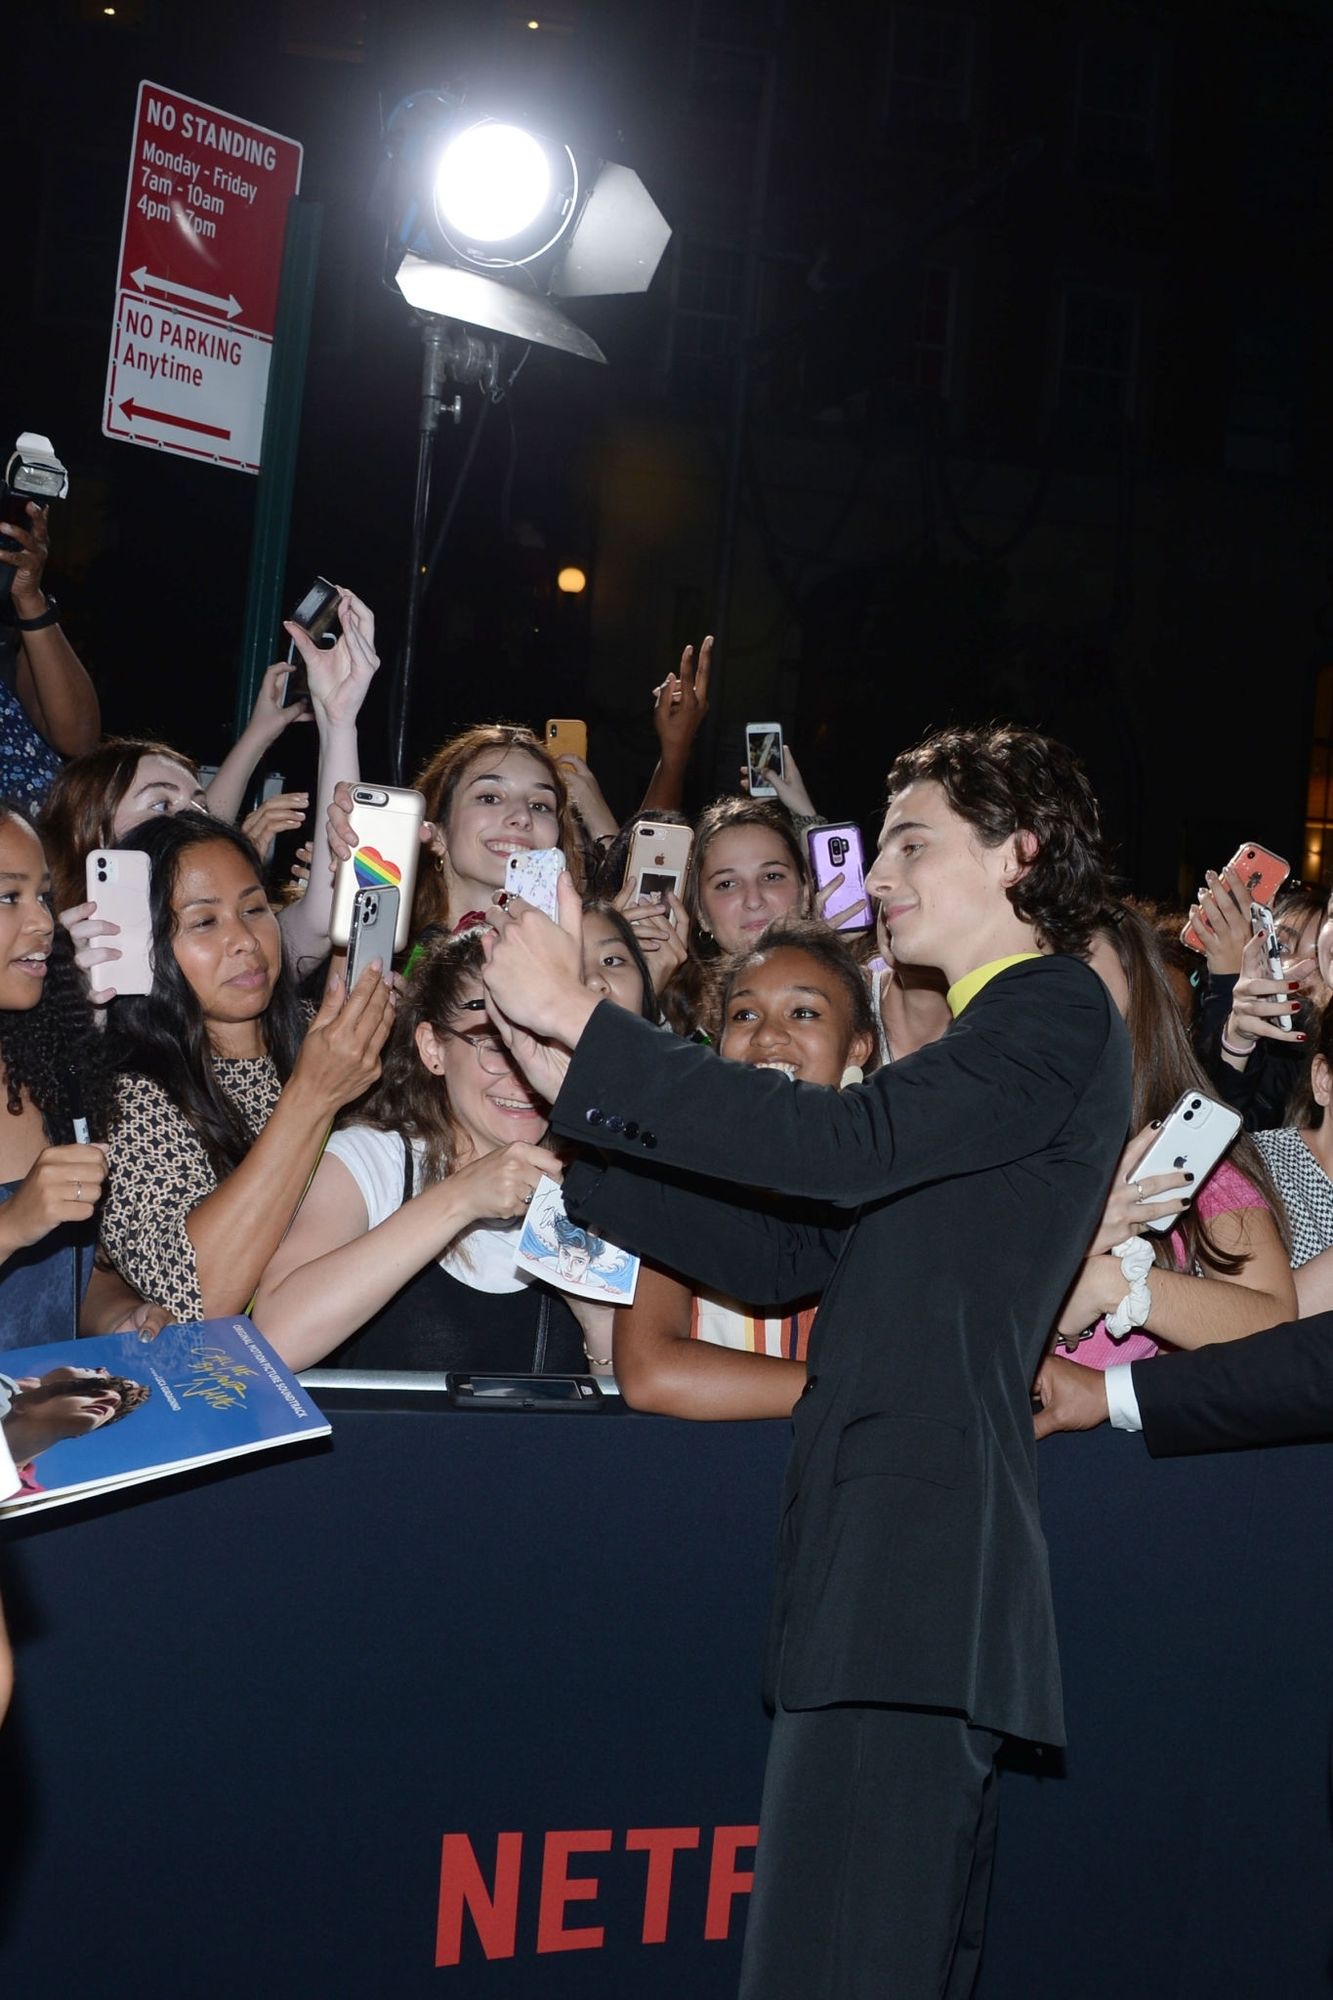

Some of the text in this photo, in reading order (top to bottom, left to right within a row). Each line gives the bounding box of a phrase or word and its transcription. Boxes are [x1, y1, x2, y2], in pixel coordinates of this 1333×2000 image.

[146, 98, 276, 171] NO STANDING
[141, 165, 172, 196] 7am
[187, 183, 225, 215] 10am
[142, 139, 200, 183] Monday
[213, 166, 257, 203] Friday
[137, 193, 171, 223] 4pm
[186, 208, 216, 239] 7pm
[123, 342, 203, 386] Anytime
[126, 309, 242, 366] NO PARKING
[233, 1324, 309, 1419] ORIGINAL MOTION PICTURE SOUNDTRACK
